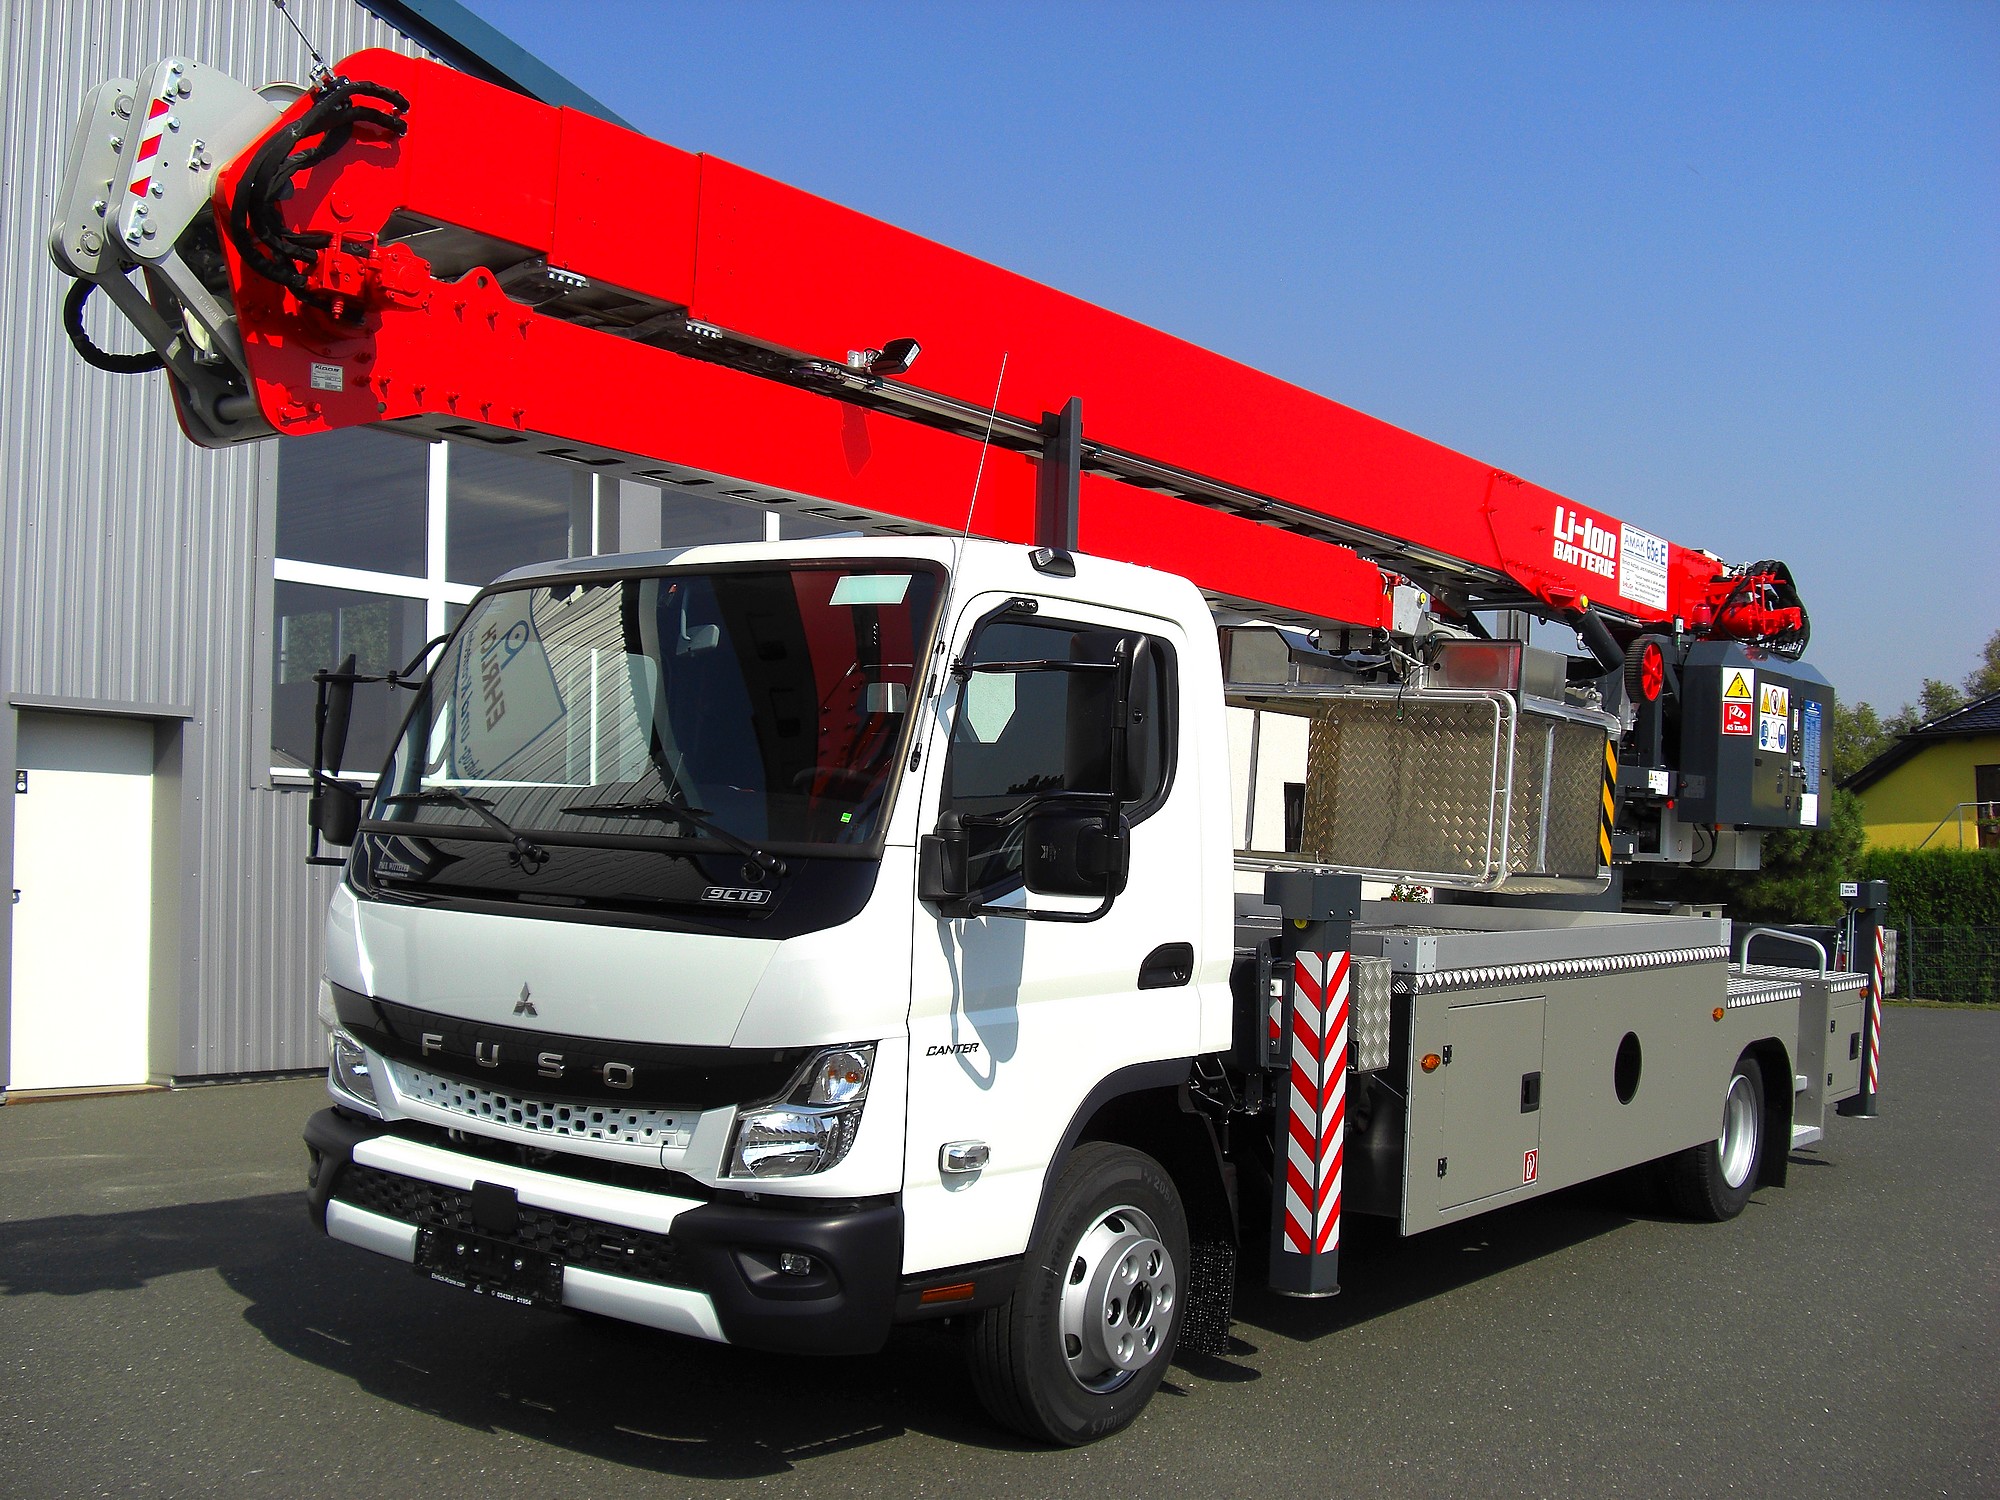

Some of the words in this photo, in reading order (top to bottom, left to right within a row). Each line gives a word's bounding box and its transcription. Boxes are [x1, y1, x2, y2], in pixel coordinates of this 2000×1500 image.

[1553, 505, 1617, 559] Li-Ion
[1553, 539, 1617, 580] BATTERIE
[708, 889, 763, 901] 9C18
[421, 1032, 635, 1090] FUSO
[926, 1042, 980, 1057] CANTER
